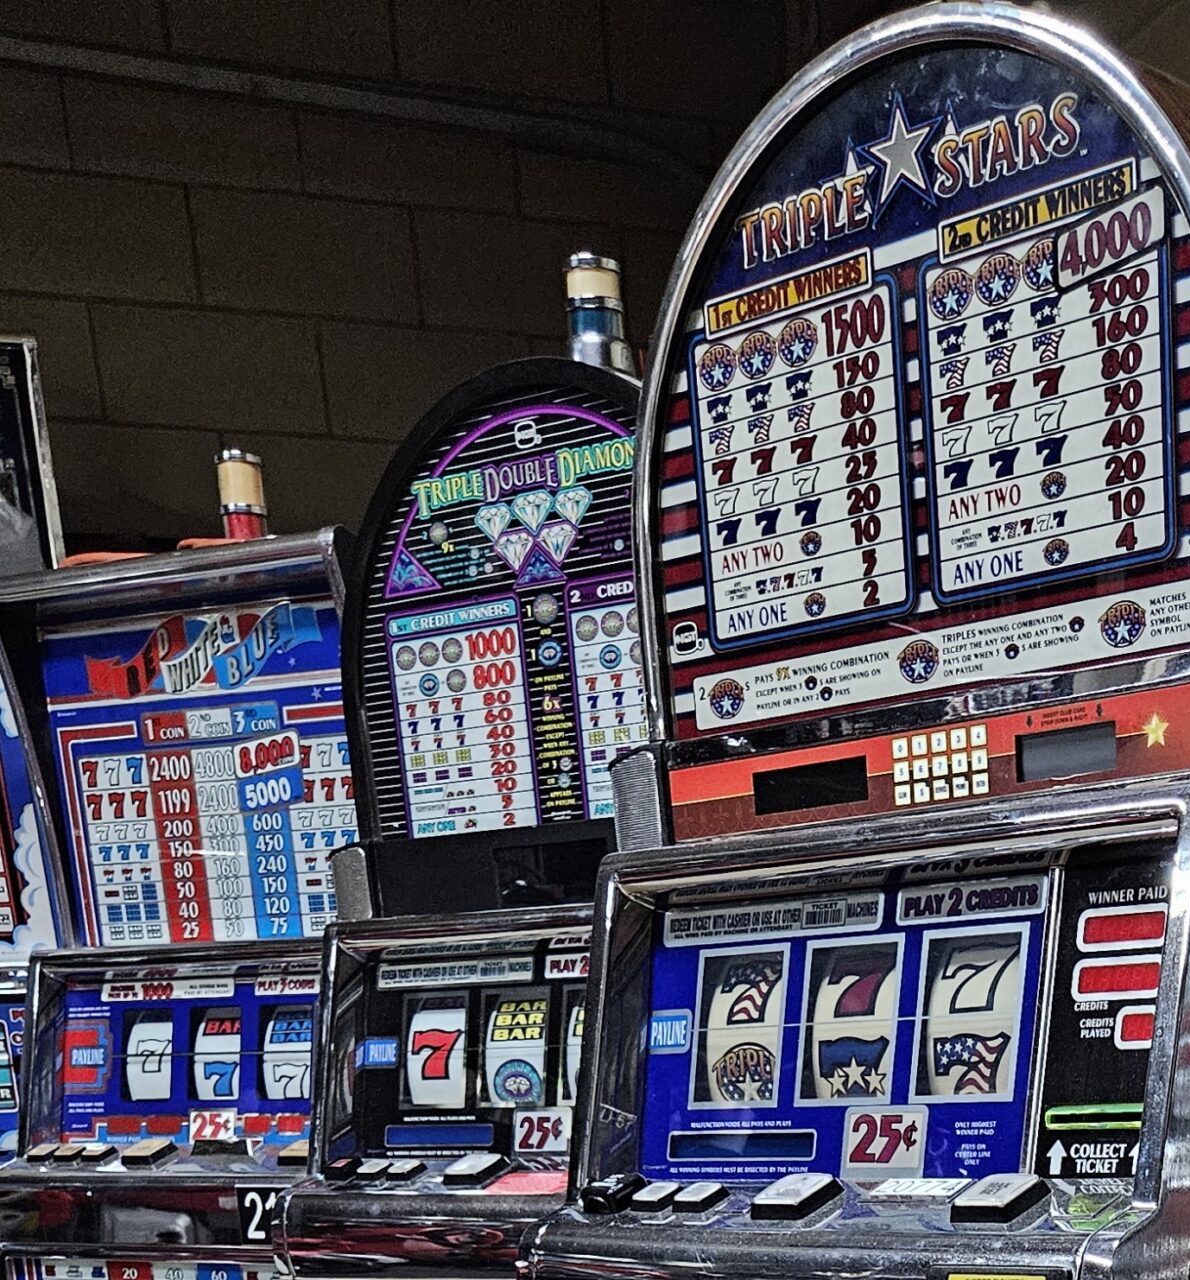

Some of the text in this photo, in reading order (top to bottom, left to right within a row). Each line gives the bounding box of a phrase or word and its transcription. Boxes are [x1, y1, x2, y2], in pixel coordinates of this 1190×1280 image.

[736, 92, 1079, 270] TRIPLE STARS
[976, 169, 1127, 244] CREDIT WINNERS
[1060, 201, 1152, 277] 4,000
[734, 257, 863, 322] CREDIT WINNERS
[821, 293, 885, 358] 1500
[1092, 304, 1149, 347] 160
[411, 469, 485, 520] TRIPLE
[483, 454, 559, 504] DOUBLE
[411, 601, 510, 632] CREDIT WINNERS
[1150, 606, 1168, 617] ANY
[166, 614, 280, 693] WHITE BLUE
[465, 626, 517, 662] 1000
[160, 716, 277, 740] COIN COIN COIN
[149, 750, 236, 783] 2400 4800
[157, 777, 291, 814] 1199 5000
[903, 884, 1038, 918] PLAY 2 CREDITS
[1088, 885, 1168, 904] WINNER PAID
[1074, 1001, 1108, 1013] CREDITS
[1079, 1017, 1114, 1030] CREDITS
[650, 1018, 687, 1046] PAYLINE
[1080, 1027, 1111, 1039] PLAYED
[192, 1112, 231, 1141] 25¢
[519, 1115, 562, 1151] 25¢
[849, 1114, 917, 1164] 25¢
[1070, 1143, 1128, 1160] COLLECT
[1075, 1158, 1119, 1174] TICKET
